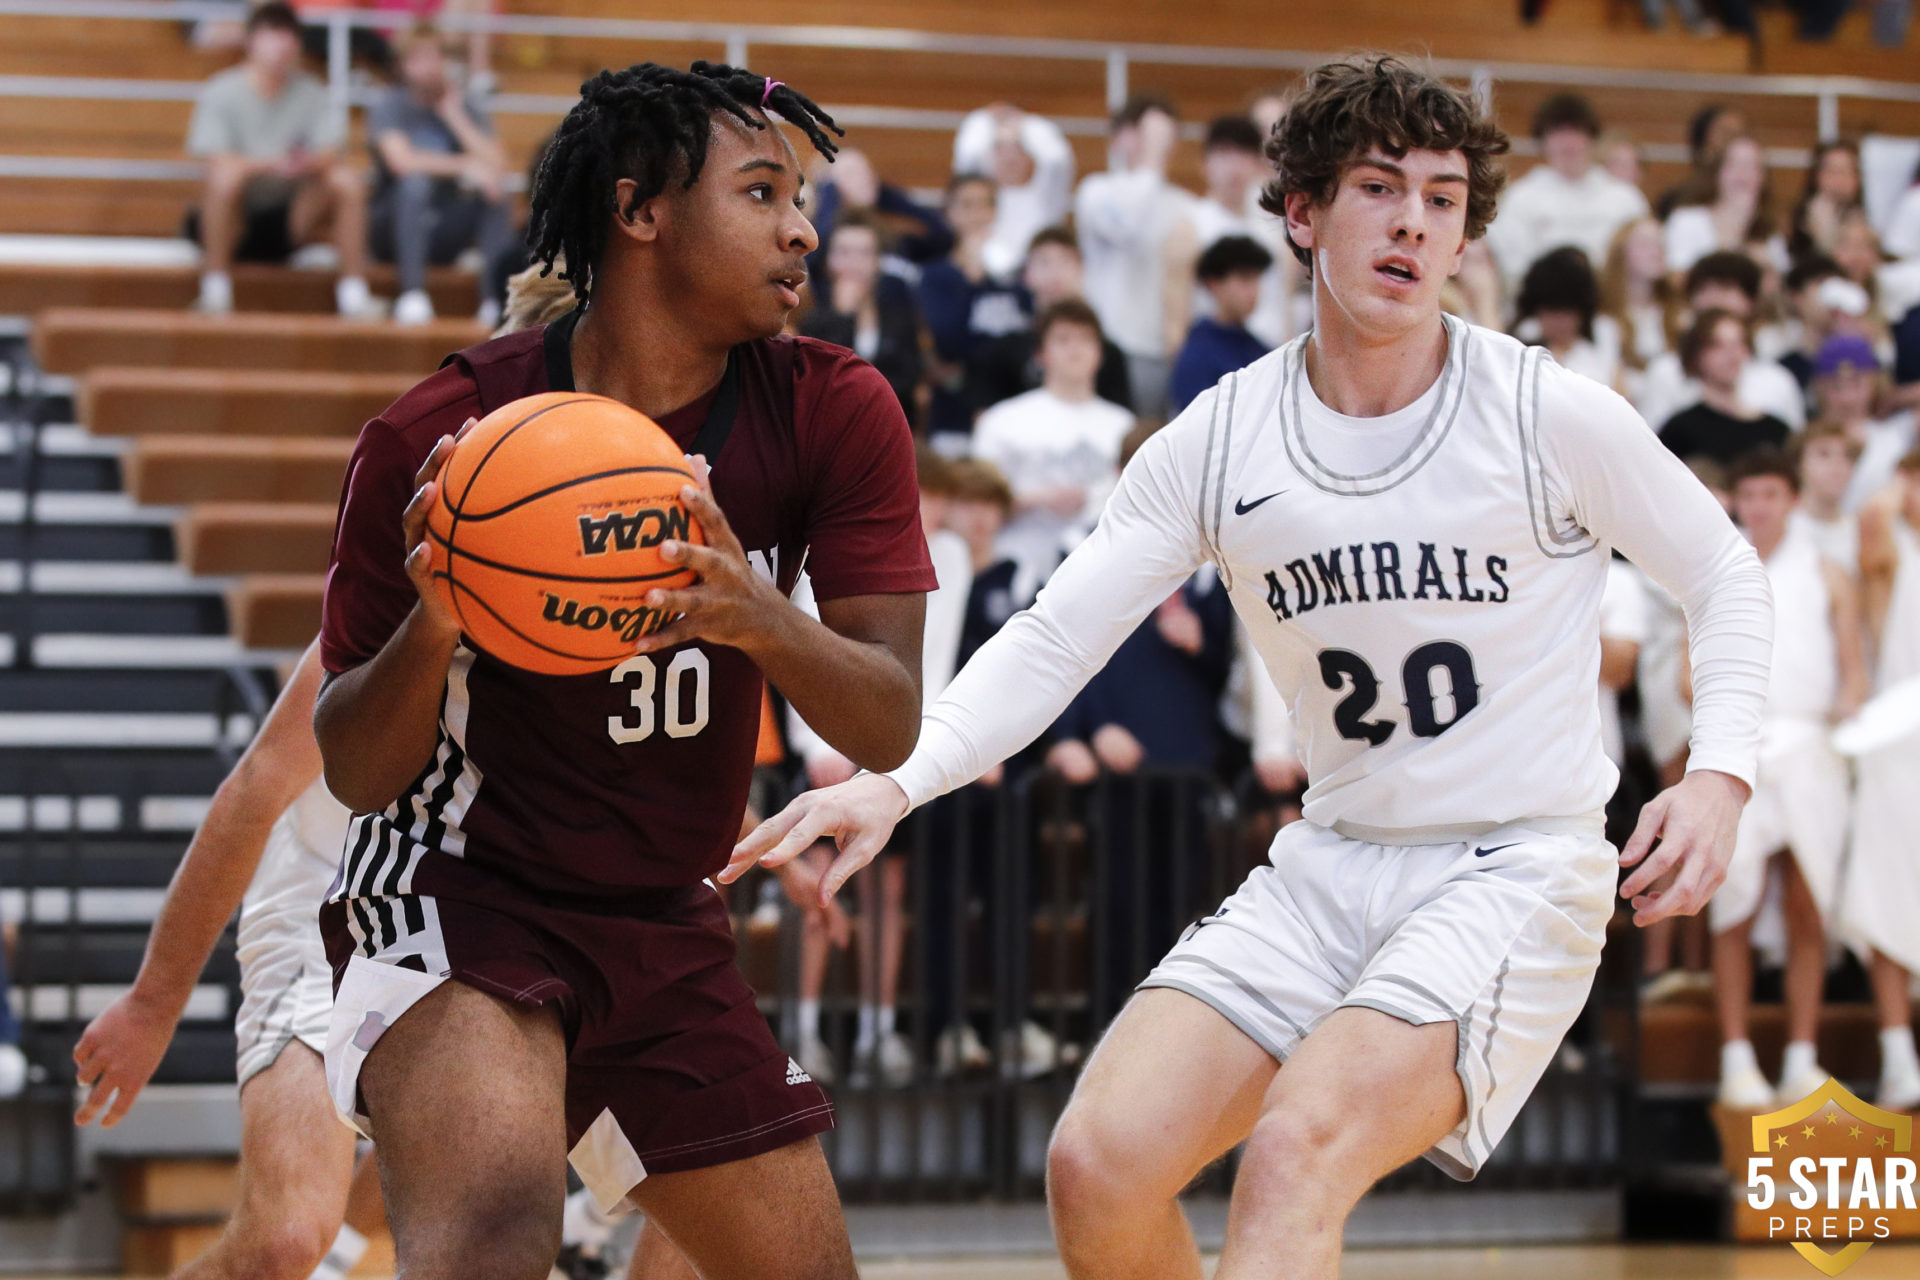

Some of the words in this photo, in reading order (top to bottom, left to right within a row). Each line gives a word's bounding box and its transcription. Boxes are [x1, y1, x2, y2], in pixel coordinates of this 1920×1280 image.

[578, 505, 691, 558] NCAA
[1263, 540, 1509, 623] ADMIRALS
[607, 647, 710, 745] 30
[1316, 639, 1485, 748] 20
